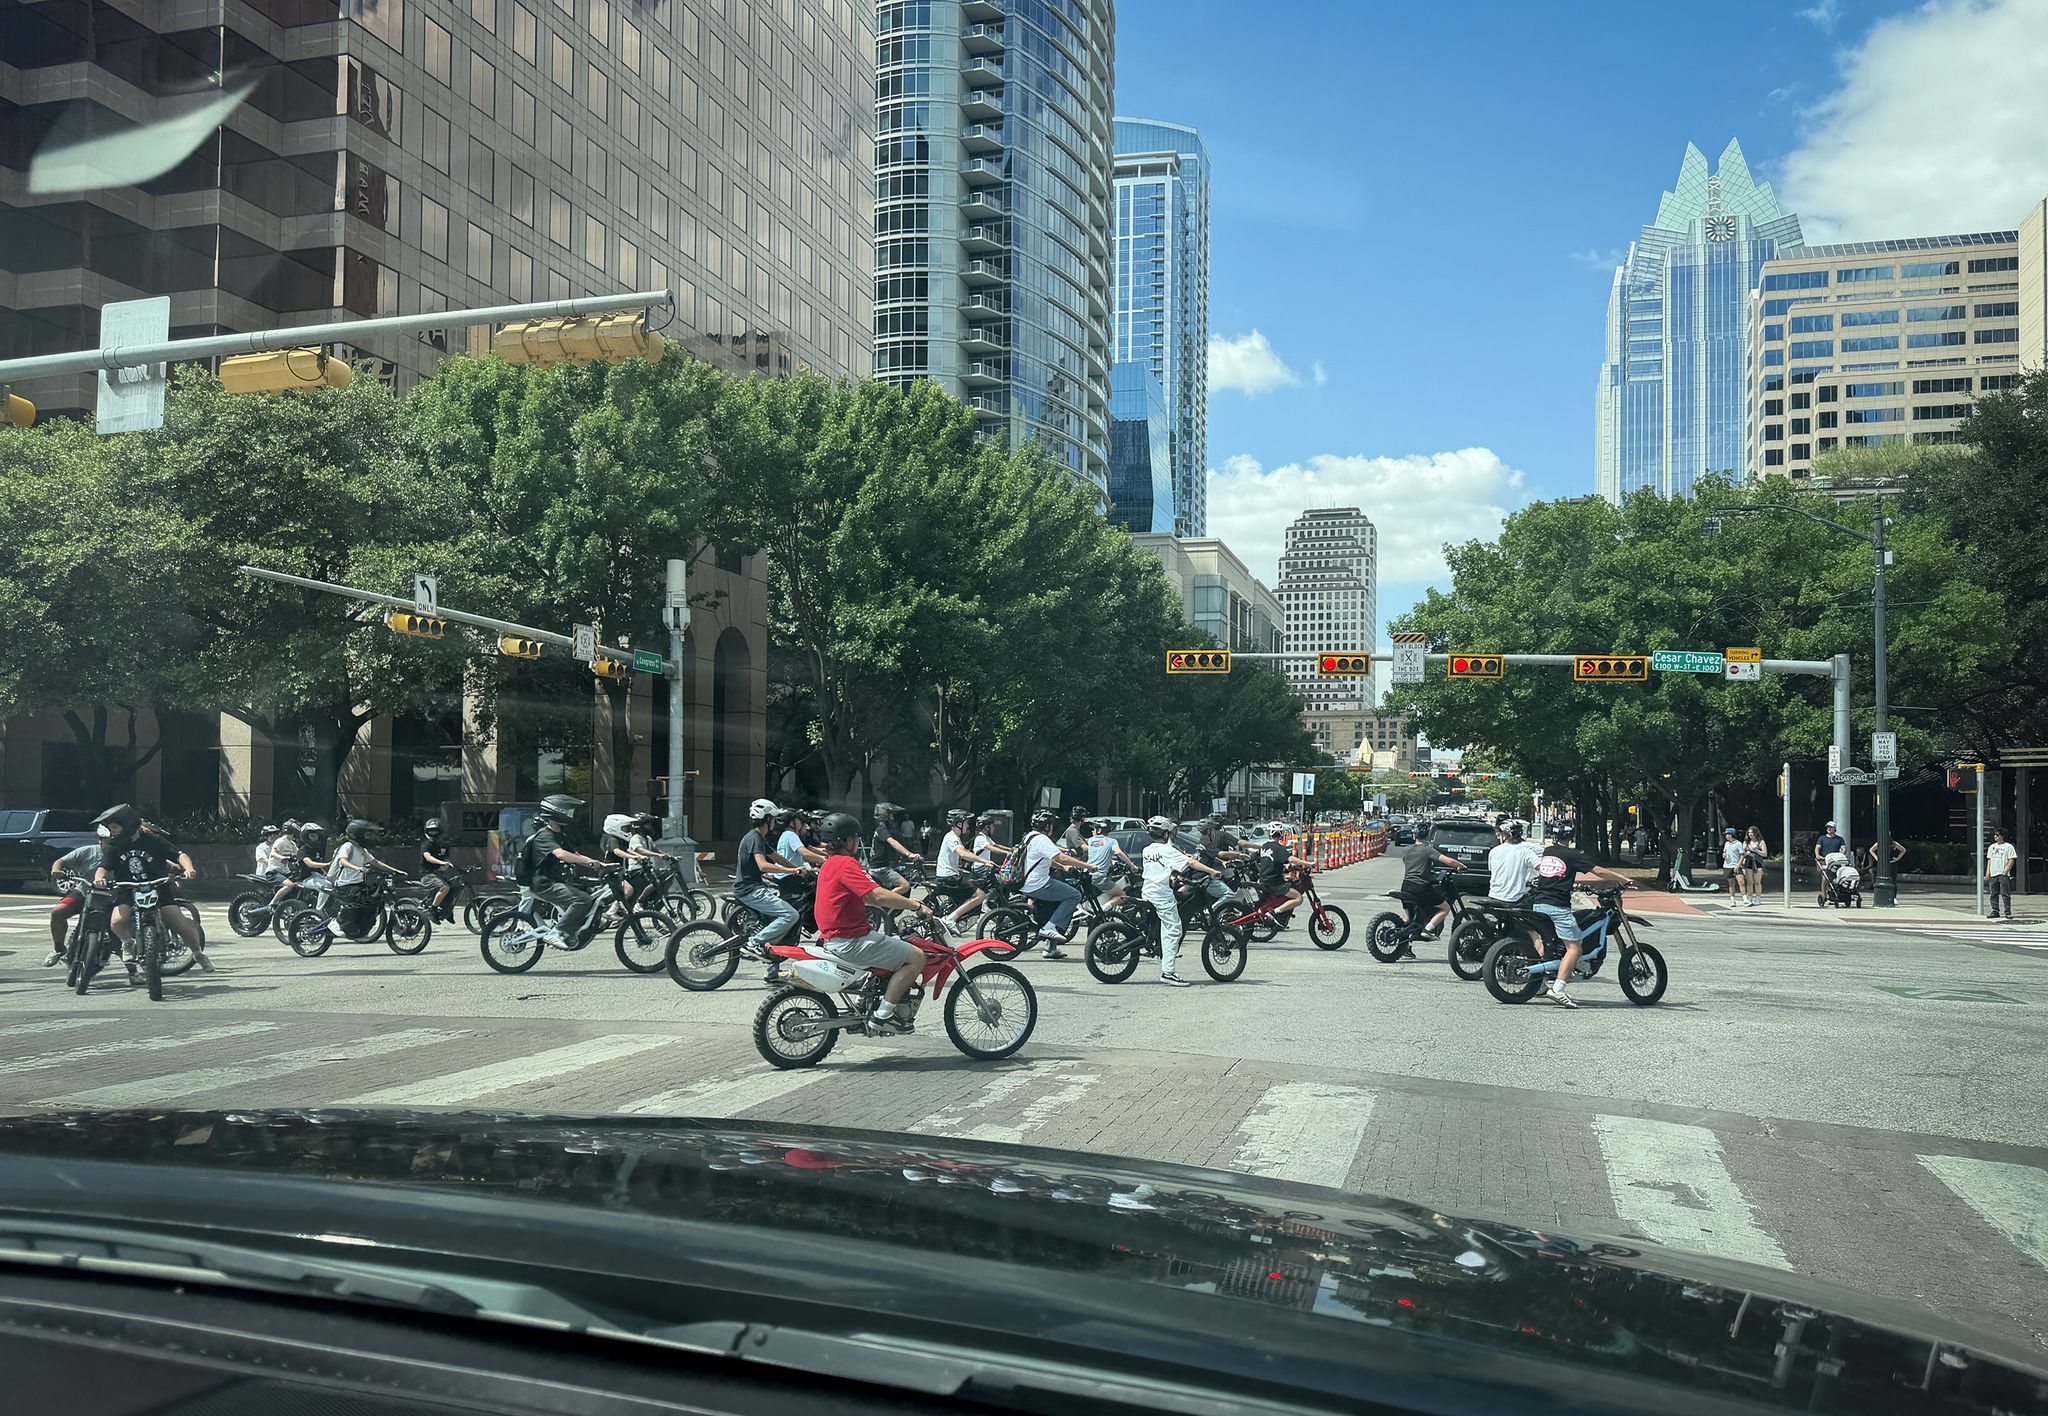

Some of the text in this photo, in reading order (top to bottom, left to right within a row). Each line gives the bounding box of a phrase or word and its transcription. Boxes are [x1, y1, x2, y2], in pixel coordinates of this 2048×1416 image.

[418, 603, 435, 613] ONLY
[1655, 652, 1720, 665] Cesar Chavez
